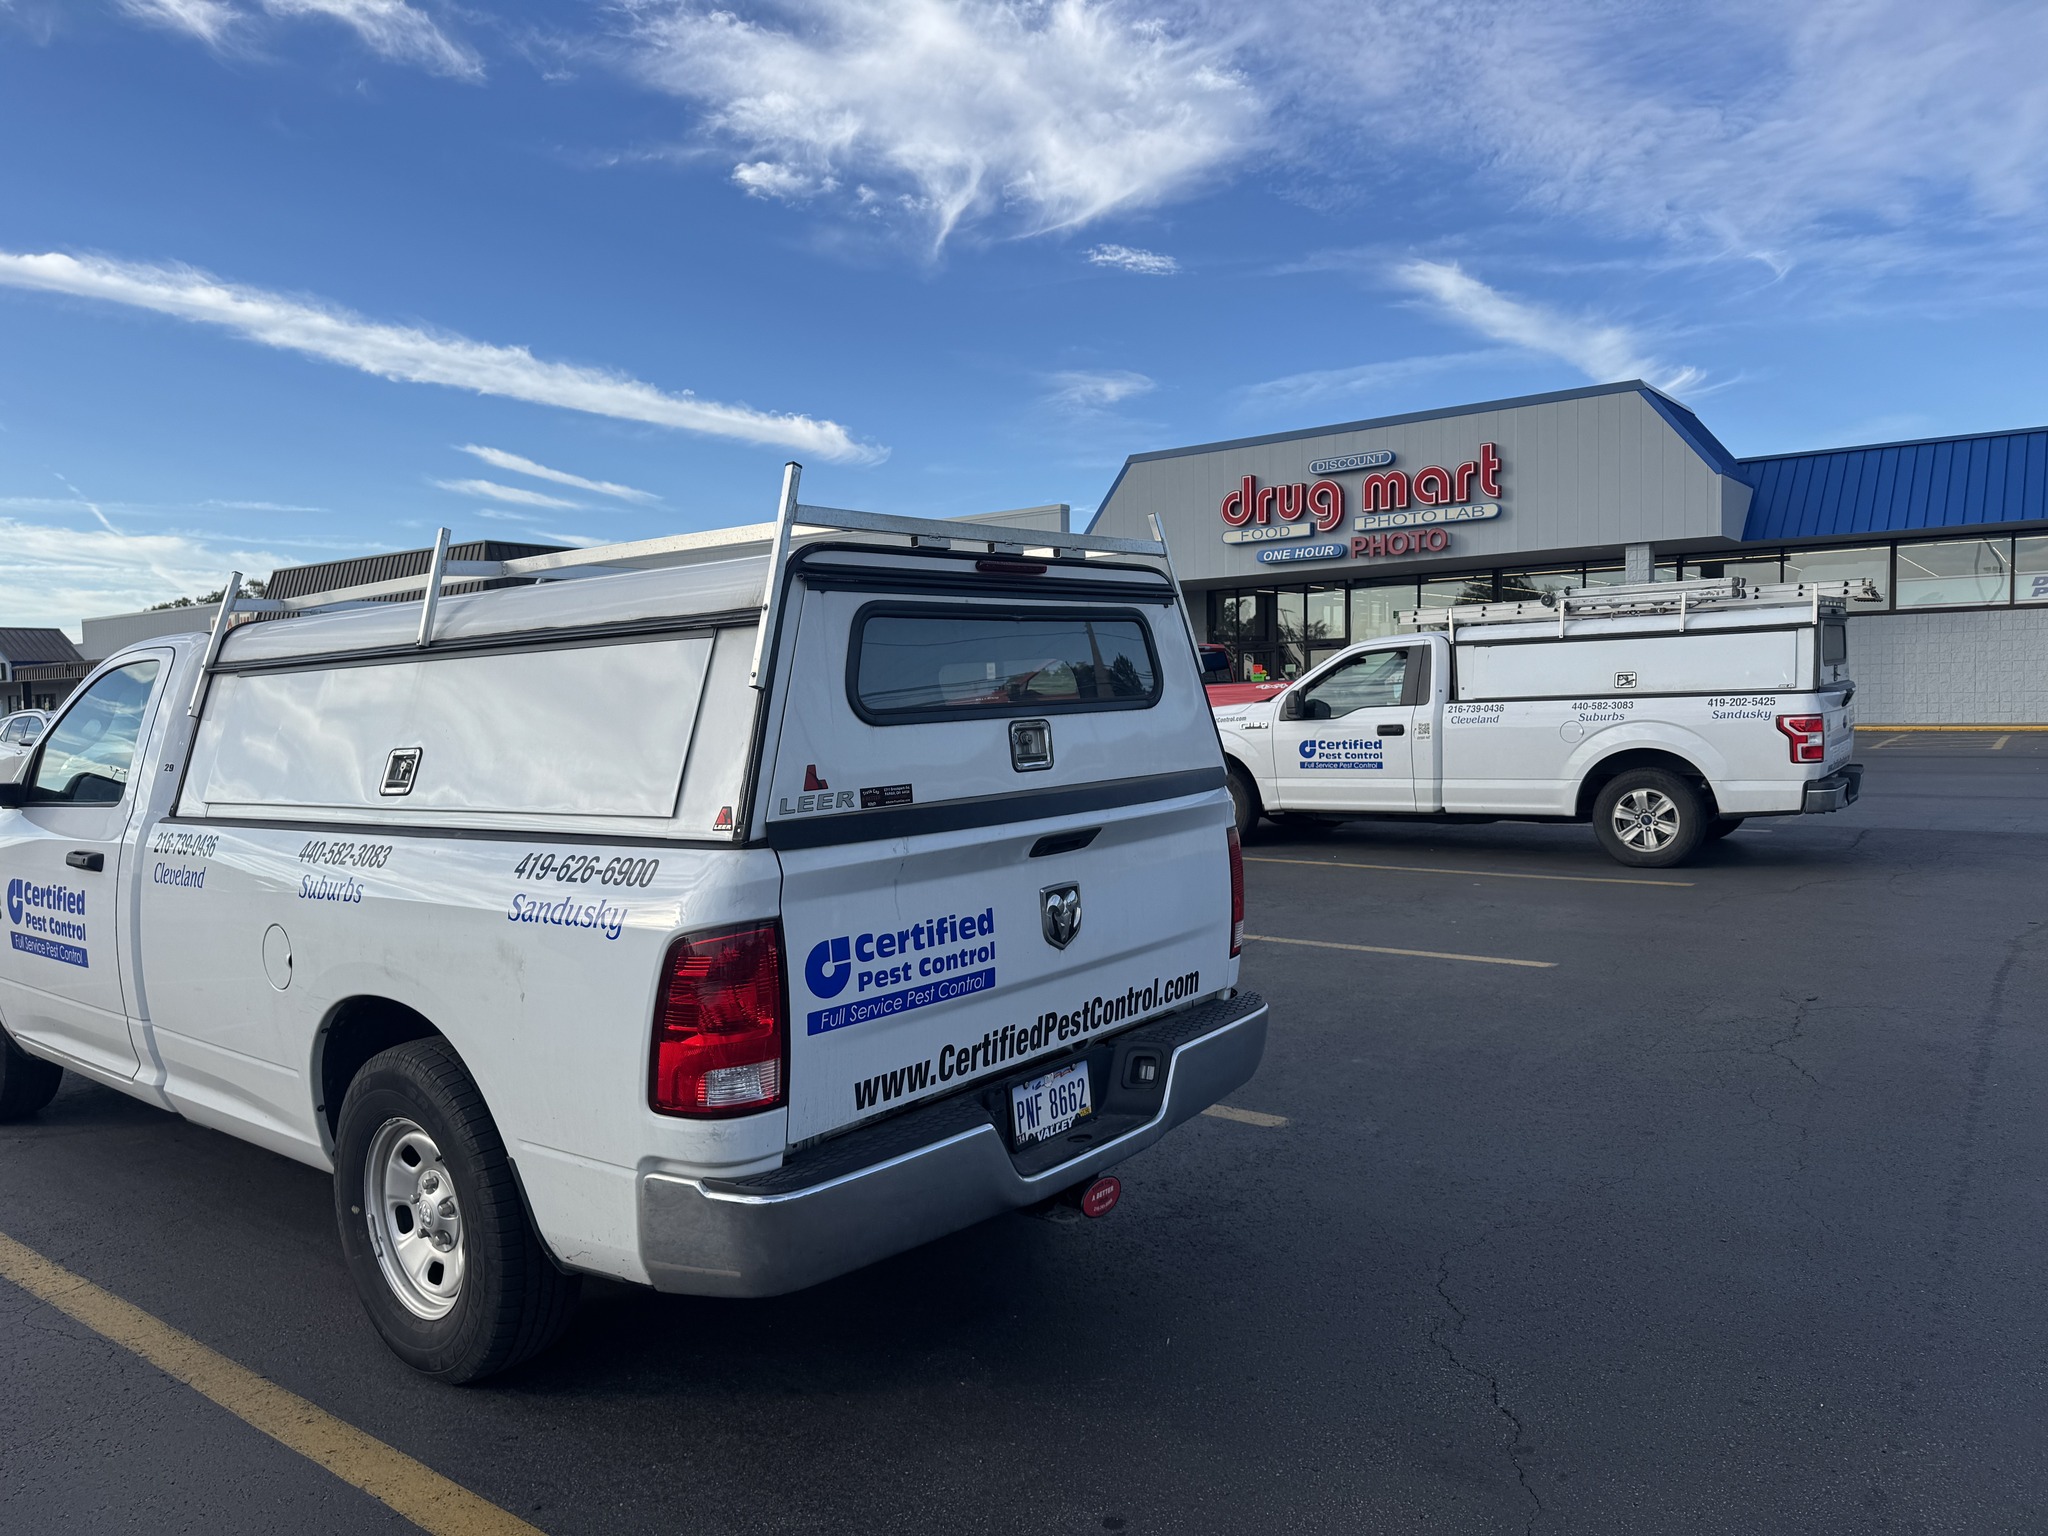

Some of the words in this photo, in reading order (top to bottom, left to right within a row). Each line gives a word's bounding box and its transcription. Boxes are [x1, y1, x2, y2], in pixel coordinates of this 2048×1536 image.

[1316, 453, 1385, 471] DISCOUNT
[1221, 474, 1345, 532] drug
[1362, 442, 1502, 512] mart
[1364, 511, 1437, 528] PHOTO
[1445, 506, 1485, 520] LAB
[1240, 526, 1291, 541] FOOD
[1351, 528, 1448, 559] PHOTO
[1263, 548, 1291, 561] ONE
[1295, 545, 1334, 558] HOUR
[1448, 704, 1505, 714] 216-739-0436
[1572, 701, 1634, 711] 440-582-3083
[1707, 697, 1776, 707] 419-202-5425
[1451, 714, 1499, 725] Cleveland
[1578, 711, 1625, 723] Suburbs
[1712, 709, 1772, 721] Sandusky
[1318, 739, 1383, 750] Certified
[1319, 752, 1342, 760] Pest
[1345, 752, 1383, 760] Control
[164, 764, 174, 772] 29
[779, 790, 855, 815] LEER
[154, 833, 219, 858] 216-739-0436
[298, 841, 393, 869] 440-582-3083
[154, 863, 207, 889] Cleveland
[514, 852, 660, 888] 419-626-6900
[25, 881, 86, 916] Certified
[298, 874, 364, 904] Suburbs
[25, 912, 47, 933] Pest
[49, 917, 87, 941] Control
[507, 893, 628, 940] Sandusky
[855, 907, 994, 962] Certified
[15, 934, 25, 948] Full
[25, 937, 46, 954] Service
[46, 942, 59, 958] Pest
[60, 946, 83, 963] Control
[858, 962, 912, 992] Pest
[919, 941, 995, 977] Control
[821, 1007, 845, 1030] Full
[850, 998, 902, 1022] Service
[907, 986, 935, 1008] Pest
[938, 972, 986, 998] Control
[854, 969, 1199, 1111] www.CertifiedPestControl.com
[1017, 1092, 1042, 1134] PNF
[1049, 1077, 1087, 1120] 8662
[1036, 1116, 1074, 1141] VALLEY
